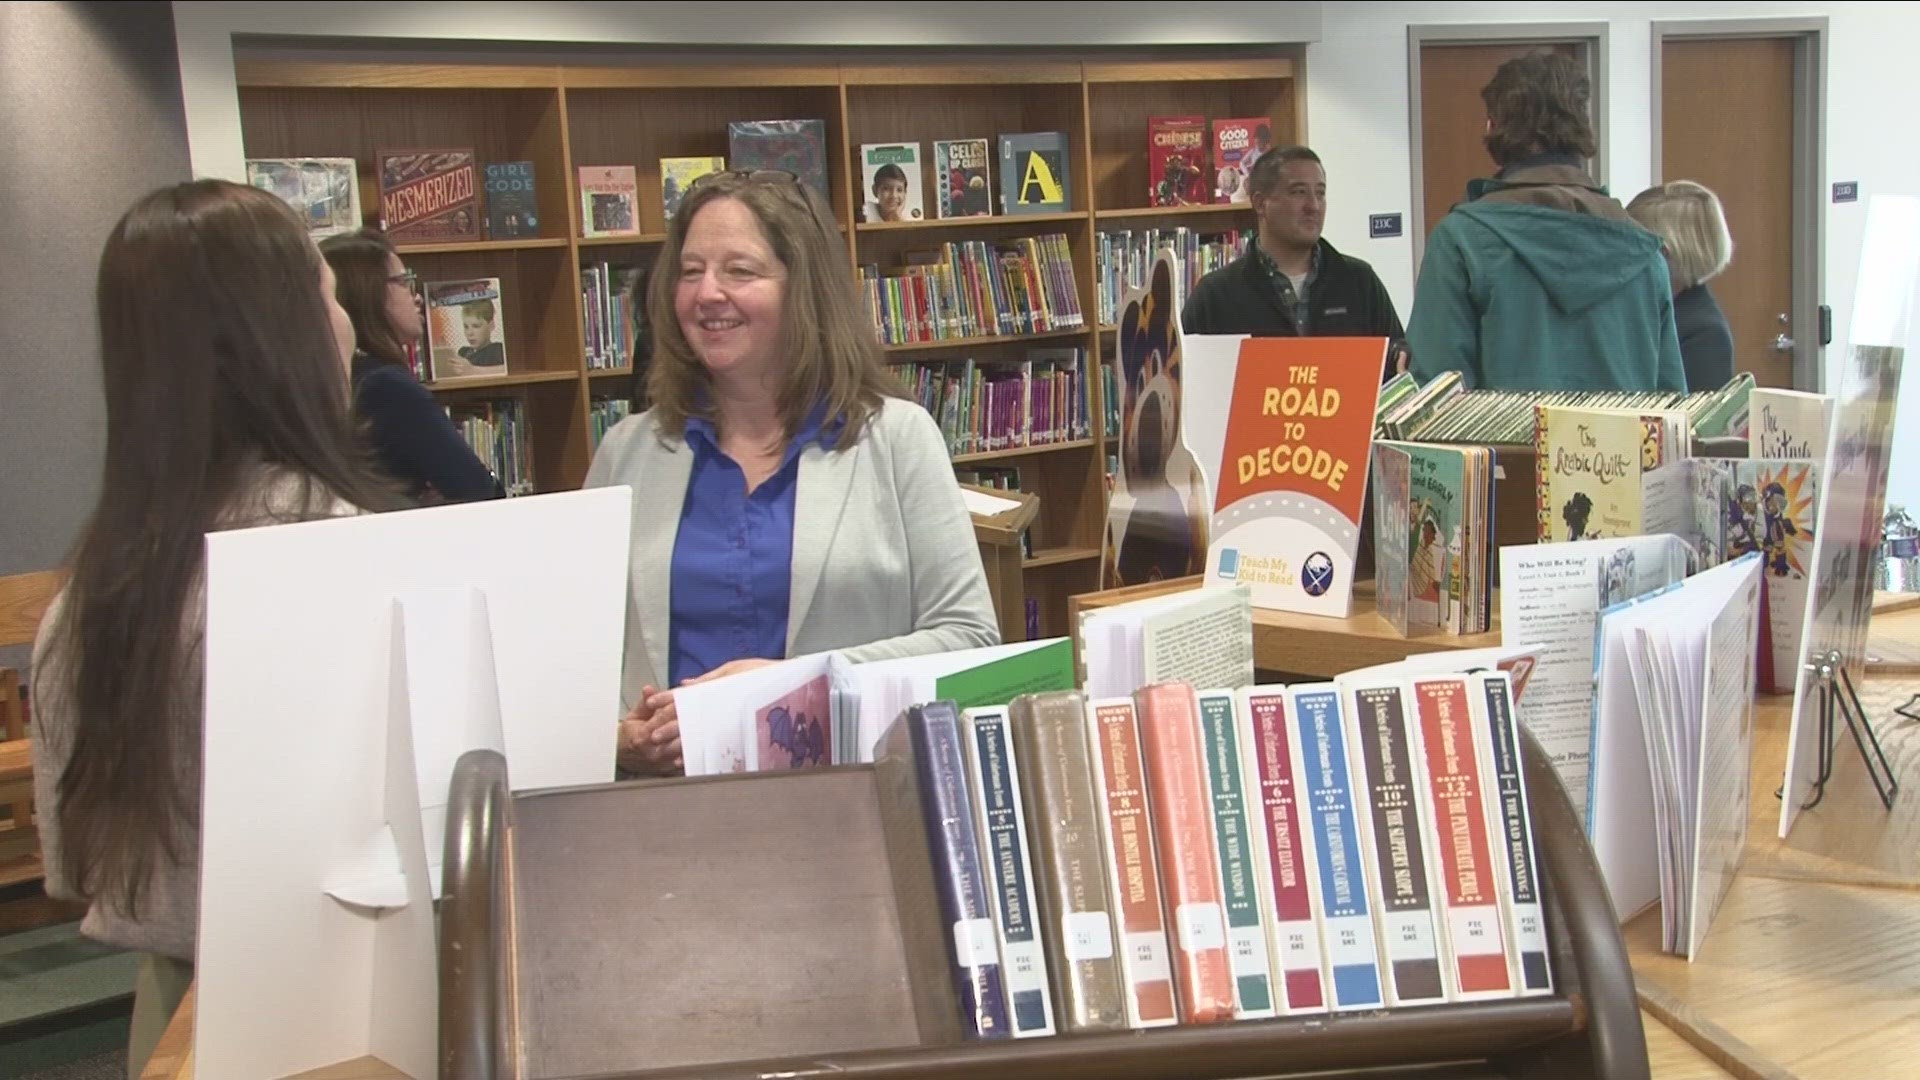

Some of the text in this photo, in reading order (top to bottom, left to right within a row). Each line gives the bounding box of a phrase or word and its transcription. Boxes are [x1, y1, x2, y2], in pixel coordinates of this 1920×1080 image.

[1220, 129, 1248, 141] GOOD
[950, 143, 985, 159] CELLS
[1220, 140, 1249, 150] CITIZEN
[486, 165, 528, 177] GIRL
[1016, 150, 1064, 205] A
[486, 179, 534, 192] CODE
[384, 165, 474, 225] MESMERIZED
[1288, 366, 1319, 384] THE
[1262, 387, 1341, 417] ROAD
[1762, 404, 1778, 433] The
[1283, 422, 1305, 440] TO
[1577, 424, 1597, 448] The
[1237, 444, 1349, 492] DECODE
[1426, 460, 1437, 473] up
[1554, 446, 1632, 485] Arabic Quilt
[1428, 477, 1453, 503] EARLY
[1241, 555, 1288, 574] Teach My
[1565, 557, 1587, 567] King?
[1239, 569, 1294, 586] Kid to Read
[1421, 683, 1461, 691] SNICKET
[1567, 751, 1590, 760] Phon
[1271, 786, 1282, 798] 6
[1383, 788, 1401, 801] 10
[1446, 779, 1466, 793] 12
[1120, 796, 1130, 807] 8
[1324, 793, 1334, 805] 9
[1446, 797, 1467, 815] THE
[1272, 804, 1287, 821] THE
[1119, 815, 1136, 832] THE
[997, 831, 1011, 848] THE
[1506, 797, 1529, 892] THE BAD BEGINNING
[1224, 817, 1245, 897] THE WIDE WINDOW
[1386, 808, 1413, 896] THE SLIPPERY SLOPE
[1070, 859, 1081, 880] THE
[1073, 884, 1085, 908] SLIP
